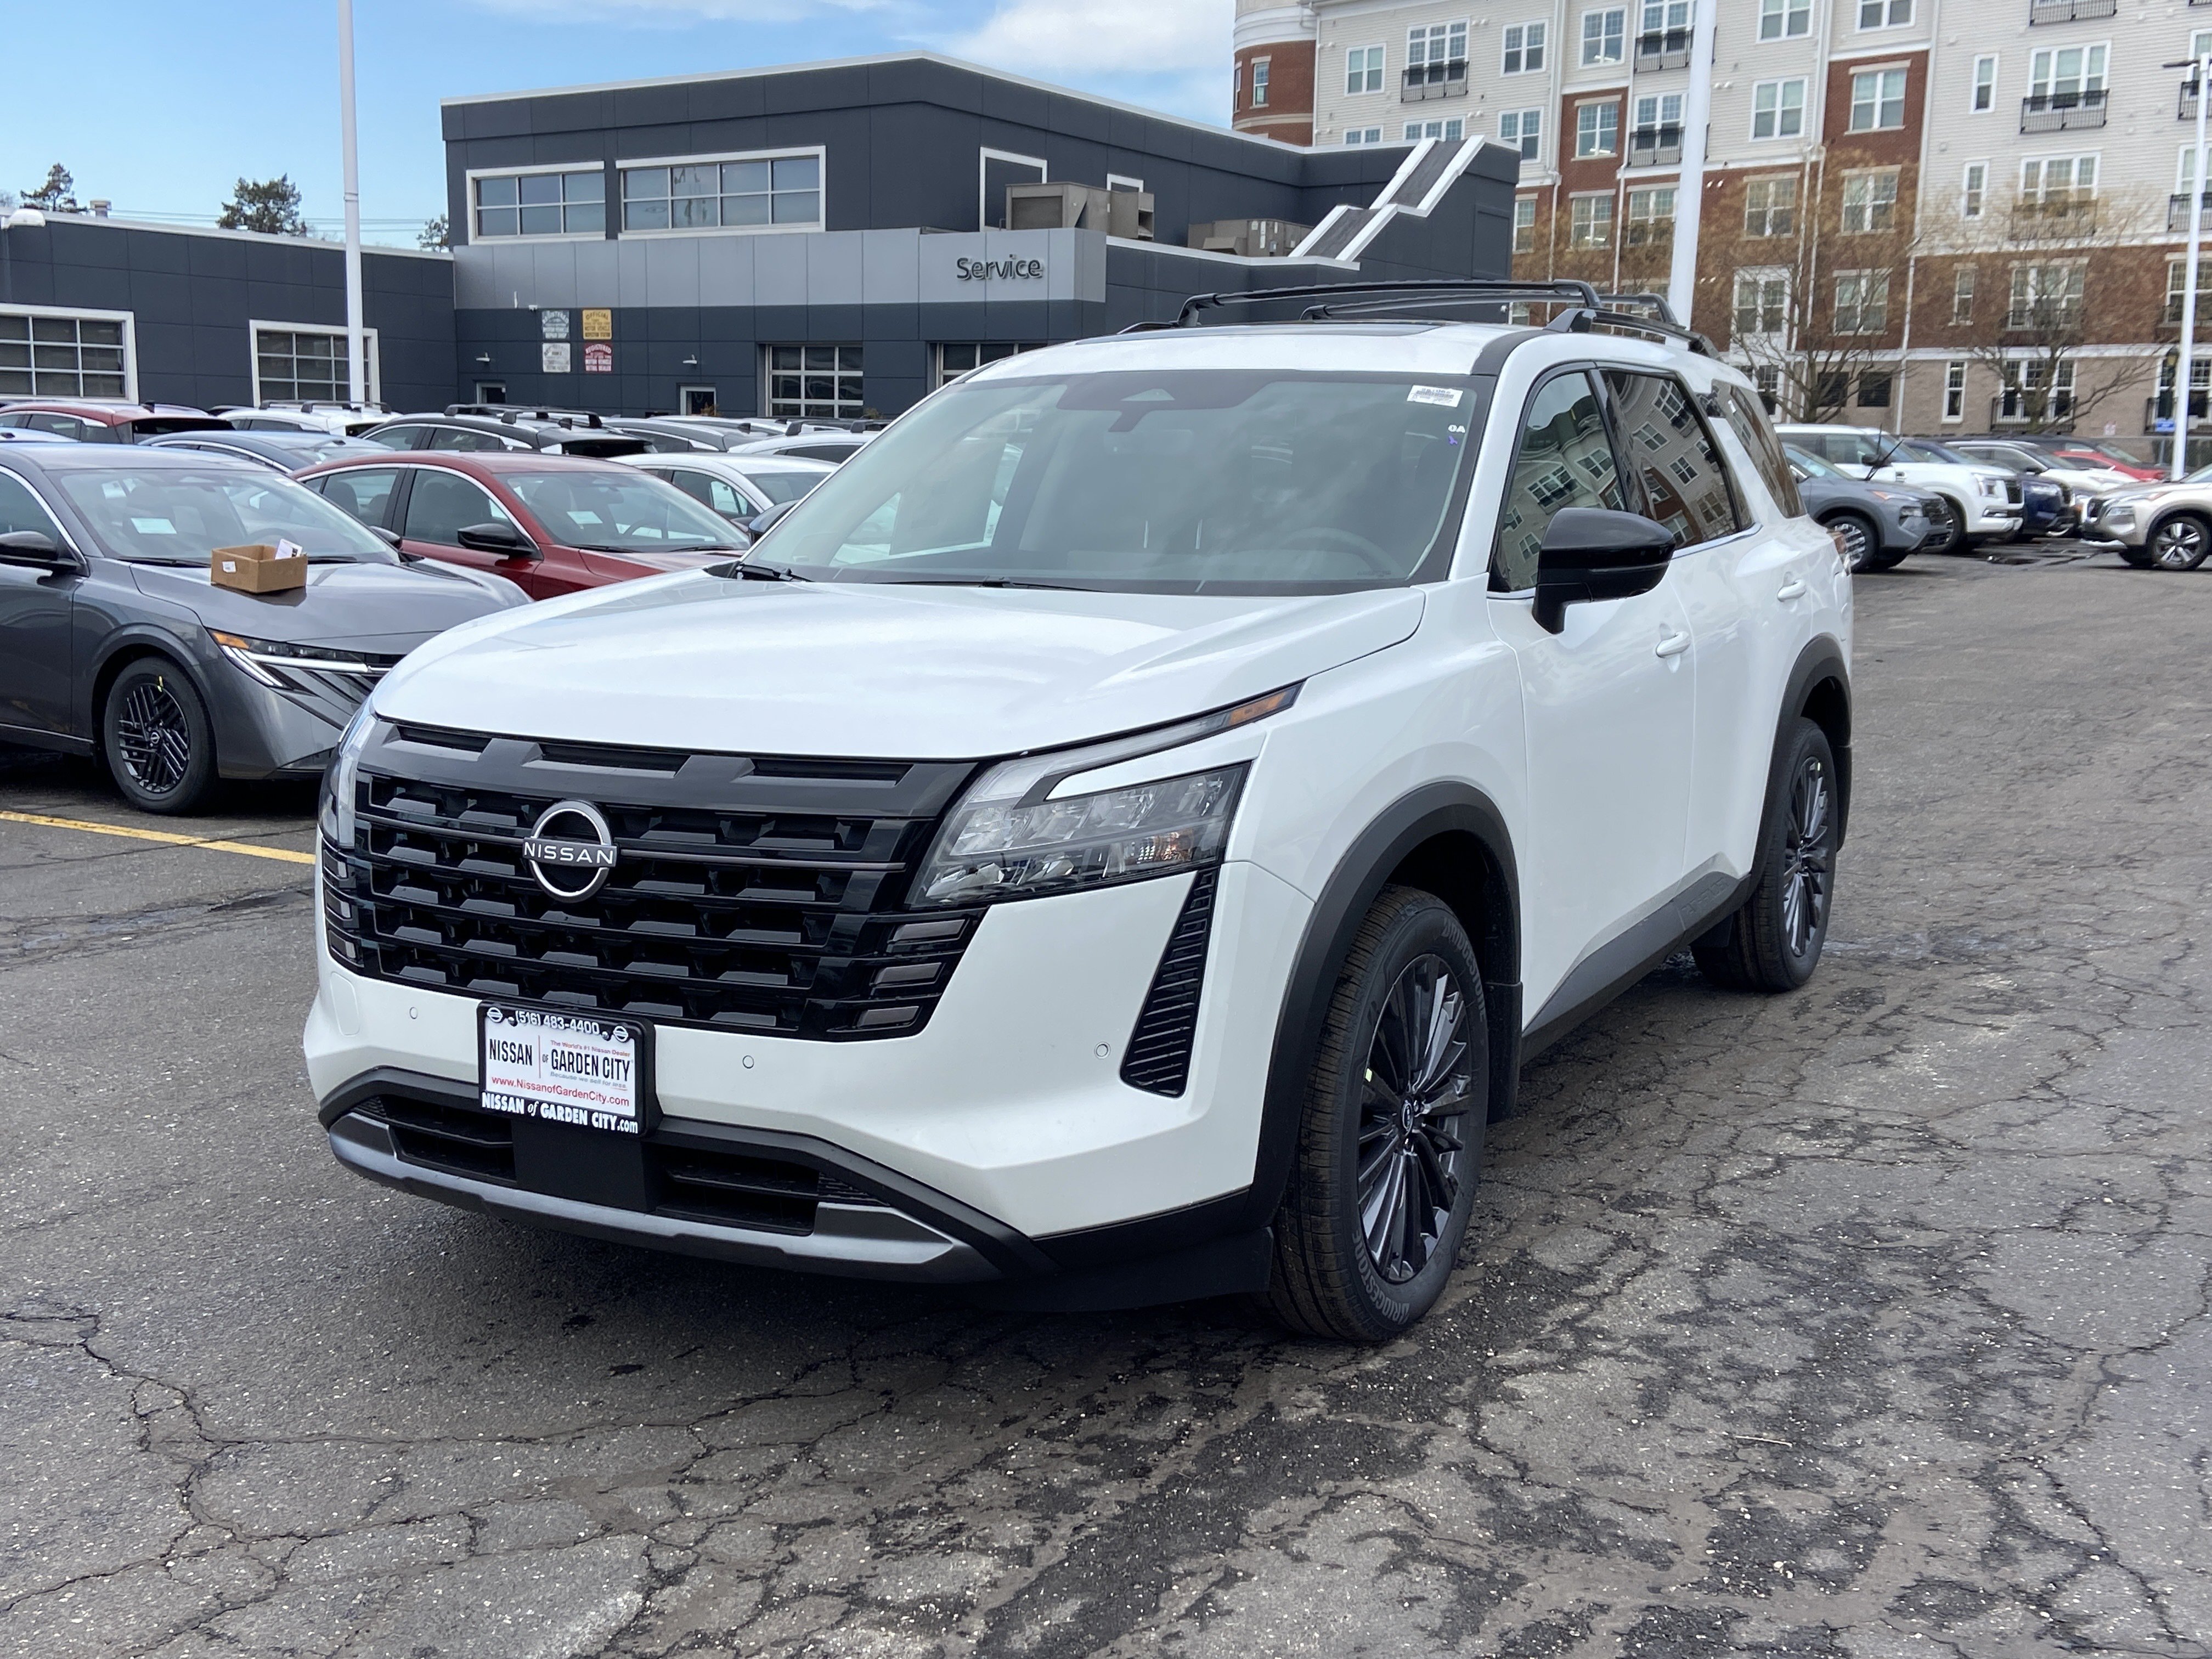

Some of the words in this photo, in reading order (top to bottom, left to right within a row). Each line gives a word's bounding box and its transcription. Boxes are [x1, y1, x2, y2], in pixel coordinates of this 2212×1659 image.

[956, 254, 1043, 279] Service
[524, 842, 613, 865] NISSAN
[1441, 916, 1486, 1023] BRIDGESTONE
[515, 1010, 541, 1026] (516)
[543, 1014, 600, 1035] 483-4400
[489, 1039, 533, 1066] NISSAN
[542, 1053, 549, 1063] OF
[551, 1048, 599, 1077] GARDEN
[602, 1057, 630, 1082] CITY
[492, 1076, 630, 1107] www.NissanofGardenCity.com
[482, 1092, 525, 1115] NISSAN
[527, 1101, 539, 1116] of
[540, 1103, 588, 1126] GARDEN
[591, 1111, 638, 1134] CITY.com
[1352, 1230, 1409, 1325] BRIDGESTONE
